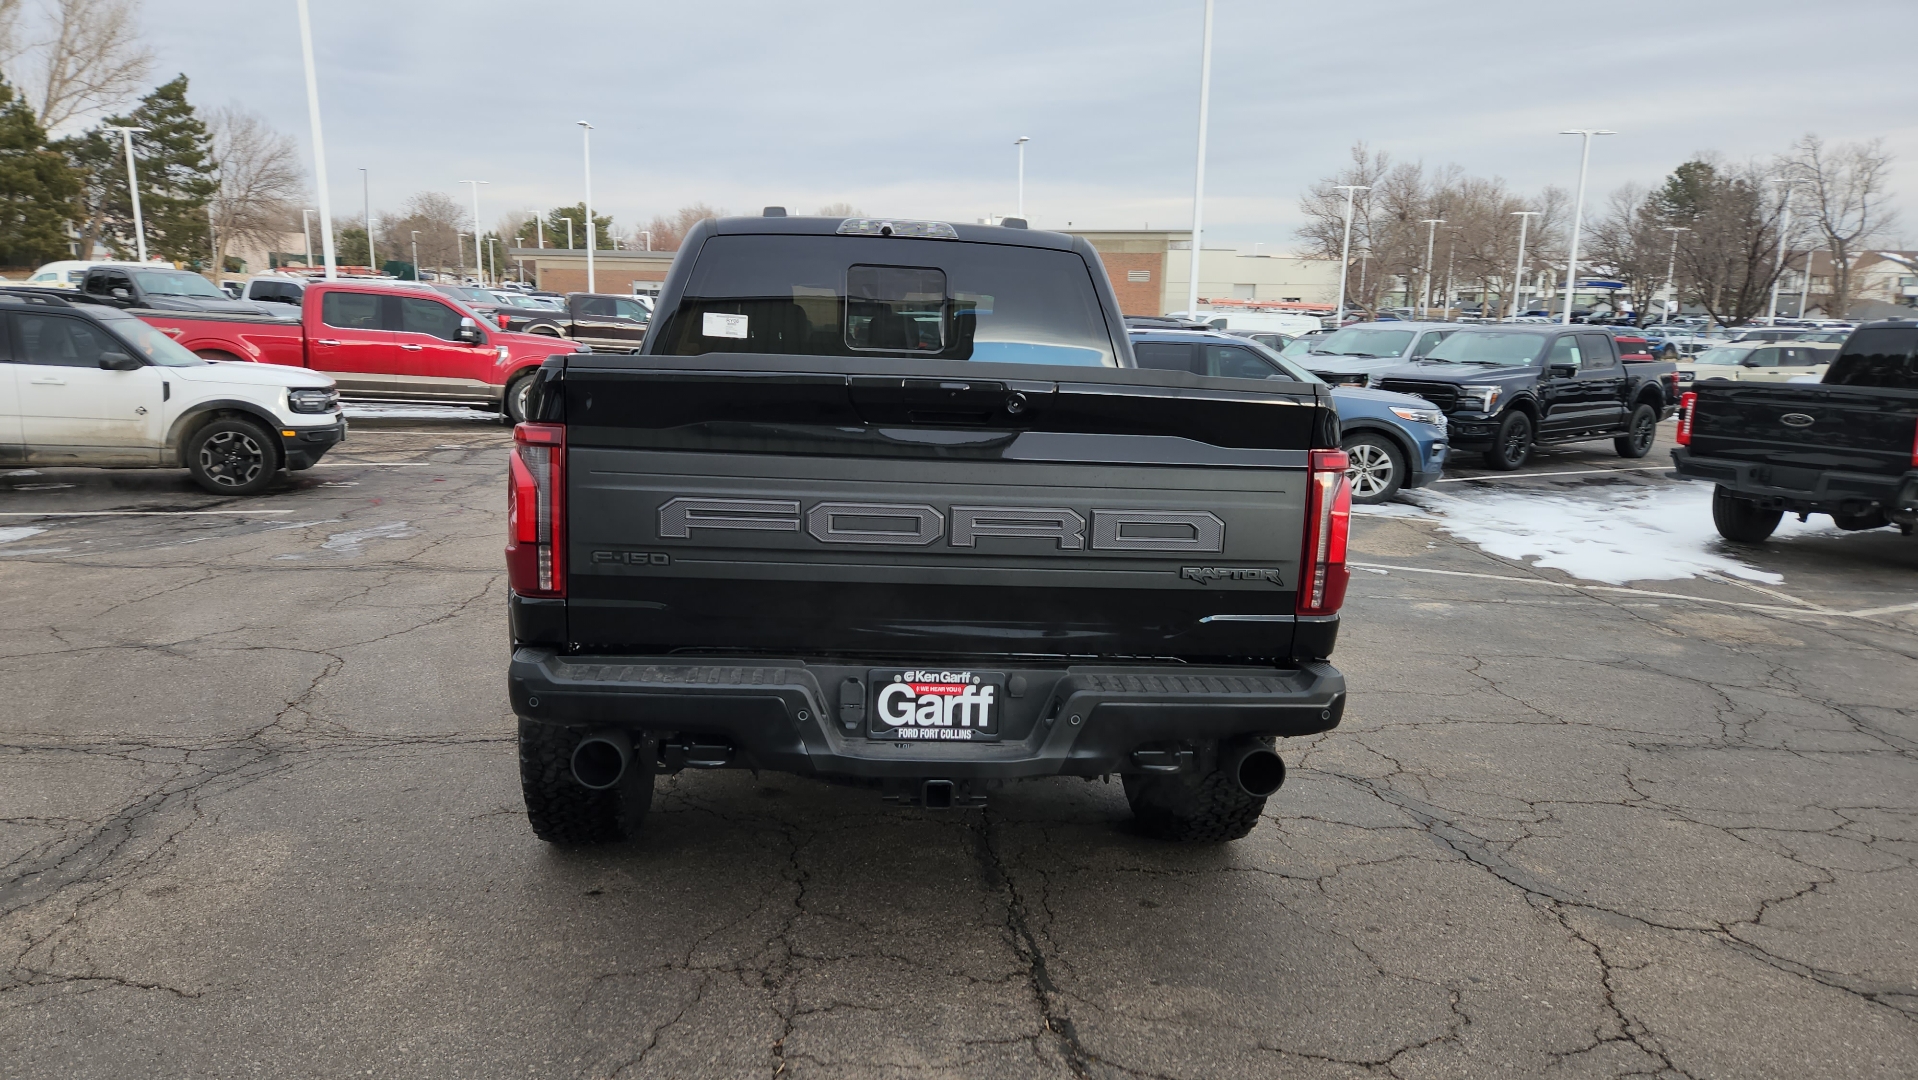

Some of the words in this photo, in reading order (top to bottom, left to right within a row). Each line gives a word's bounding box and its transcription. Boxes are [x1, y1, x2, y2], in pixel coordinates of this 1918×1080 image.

[656, 495, 1226, 553] FORD
[591, 550, 670, 566] F-150
[1181, 565, 1284, 586] RAPTOR
[915, 670, 939, 682] Ken
[940, 671, 971, 683] Garff
[877, 682, 994, 727] Garff
[898, 728, 918, 739] FORD
[920, 728, 938, 739] FORT
[940, 729, 971, 740] COLLINS
